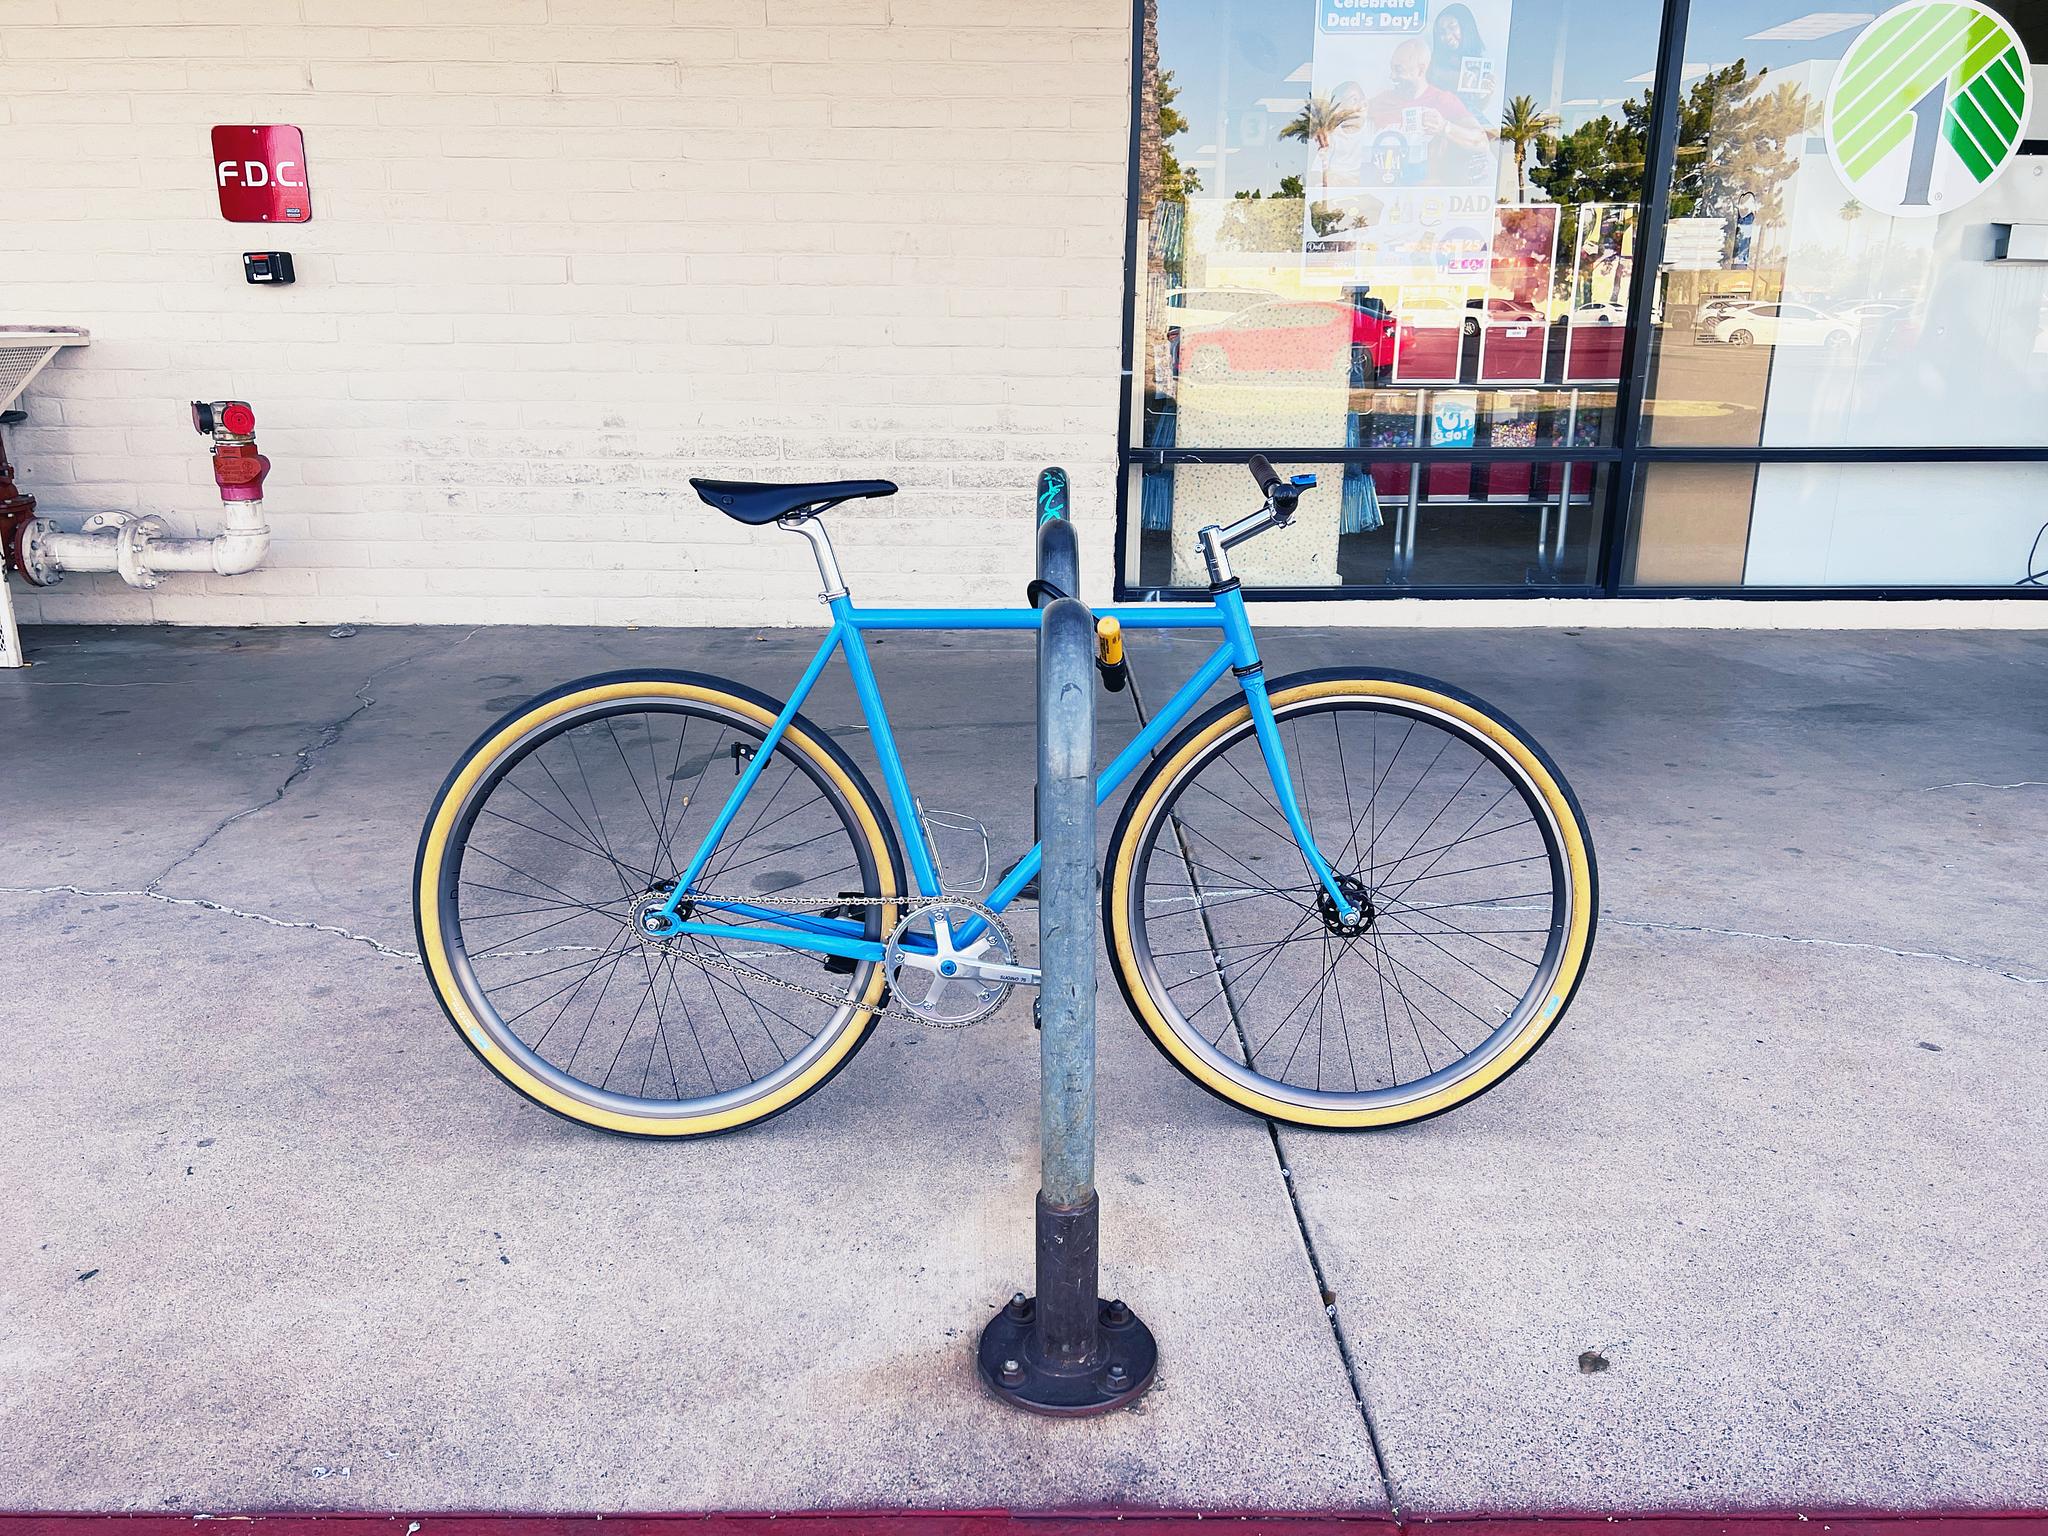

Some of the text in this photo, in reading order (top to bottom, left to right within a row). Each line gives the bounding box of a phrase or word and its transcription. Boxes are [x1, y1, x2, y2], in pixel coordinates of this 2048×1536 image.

[1327, 12, 1419, 30] Dad's Day!
[218, 161, 304, 187] F.D.C.
[1449, 195, 1491, 212] DAD
